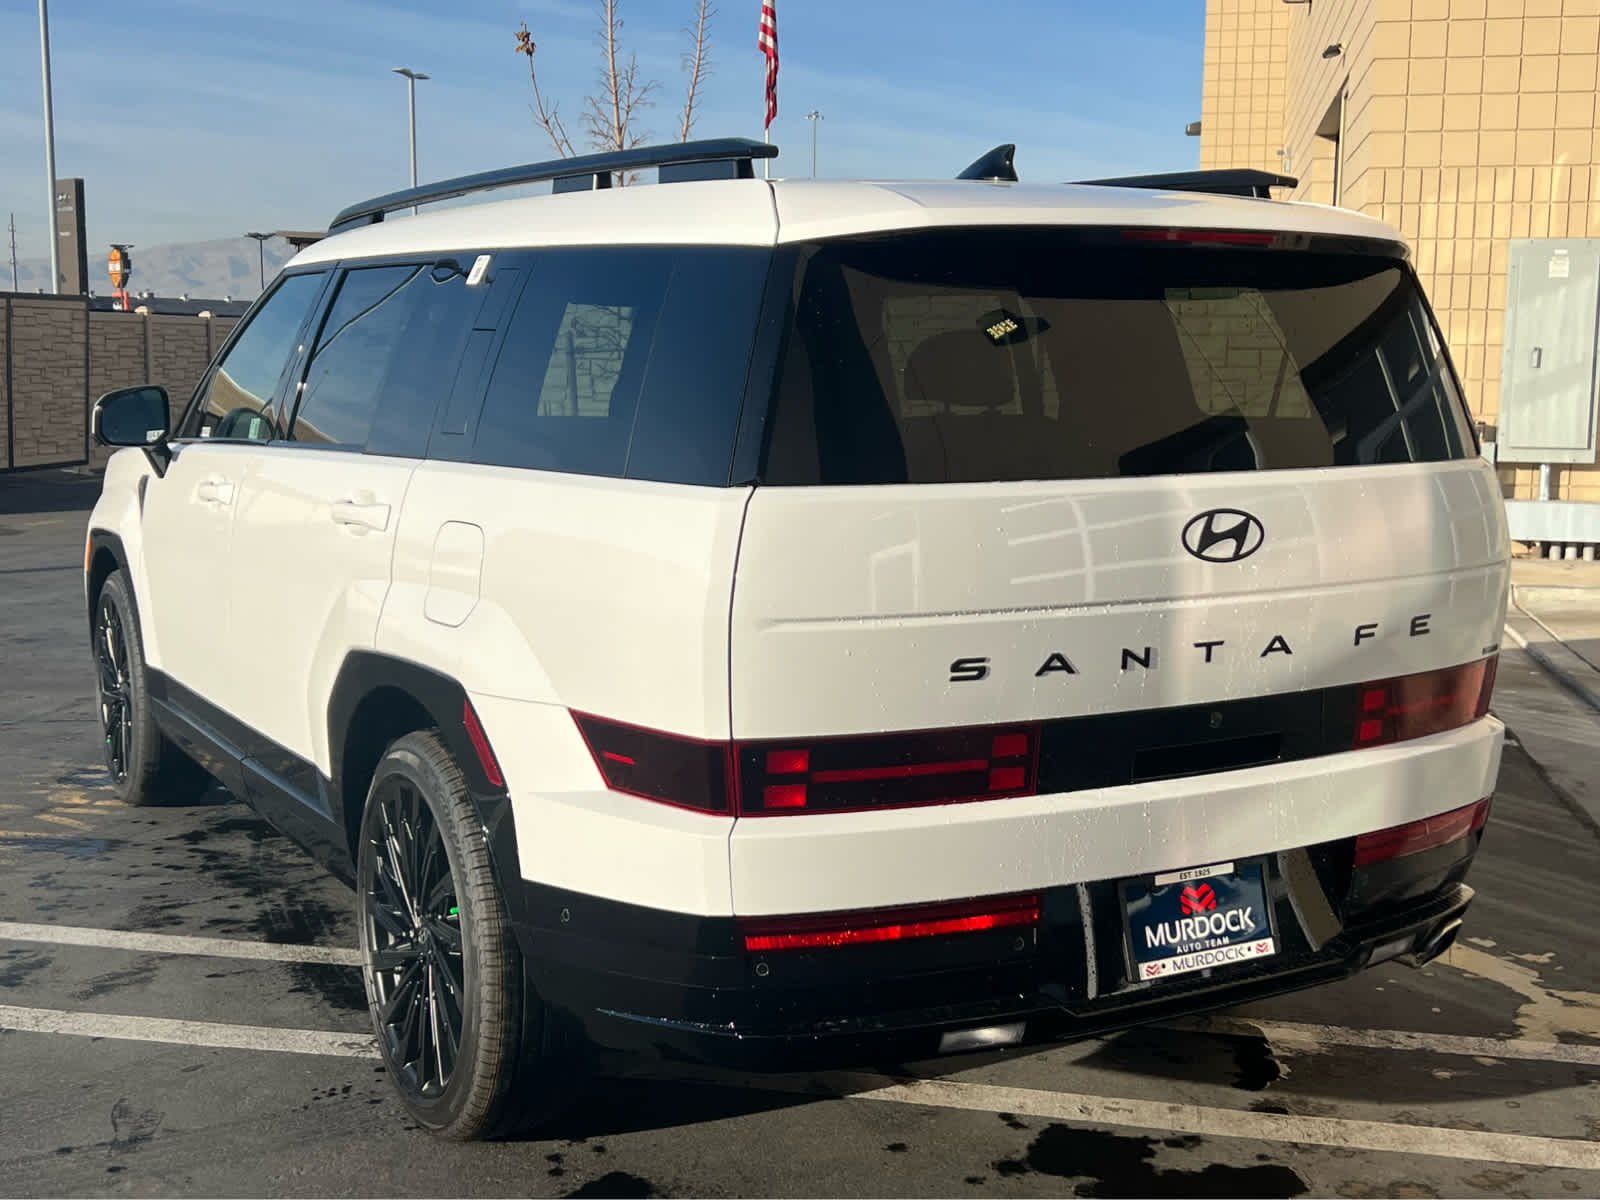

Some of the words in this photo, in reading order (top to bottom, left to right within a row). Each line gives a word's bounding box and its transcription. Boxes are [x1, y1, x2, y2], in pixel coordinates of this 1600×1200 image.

[949, 635, 1293, 682] SANTA
[1354, 614, 1431, 646] FE
[1179, 871, 1192, 880] EST
[1145, 907, 1255, 948] MURDOCK
[1176, 942, 1200, 954] AUTO
[1204, 936, 1230, 949] TEAM
[1172, 946, 1246, 972] MURDOCK
